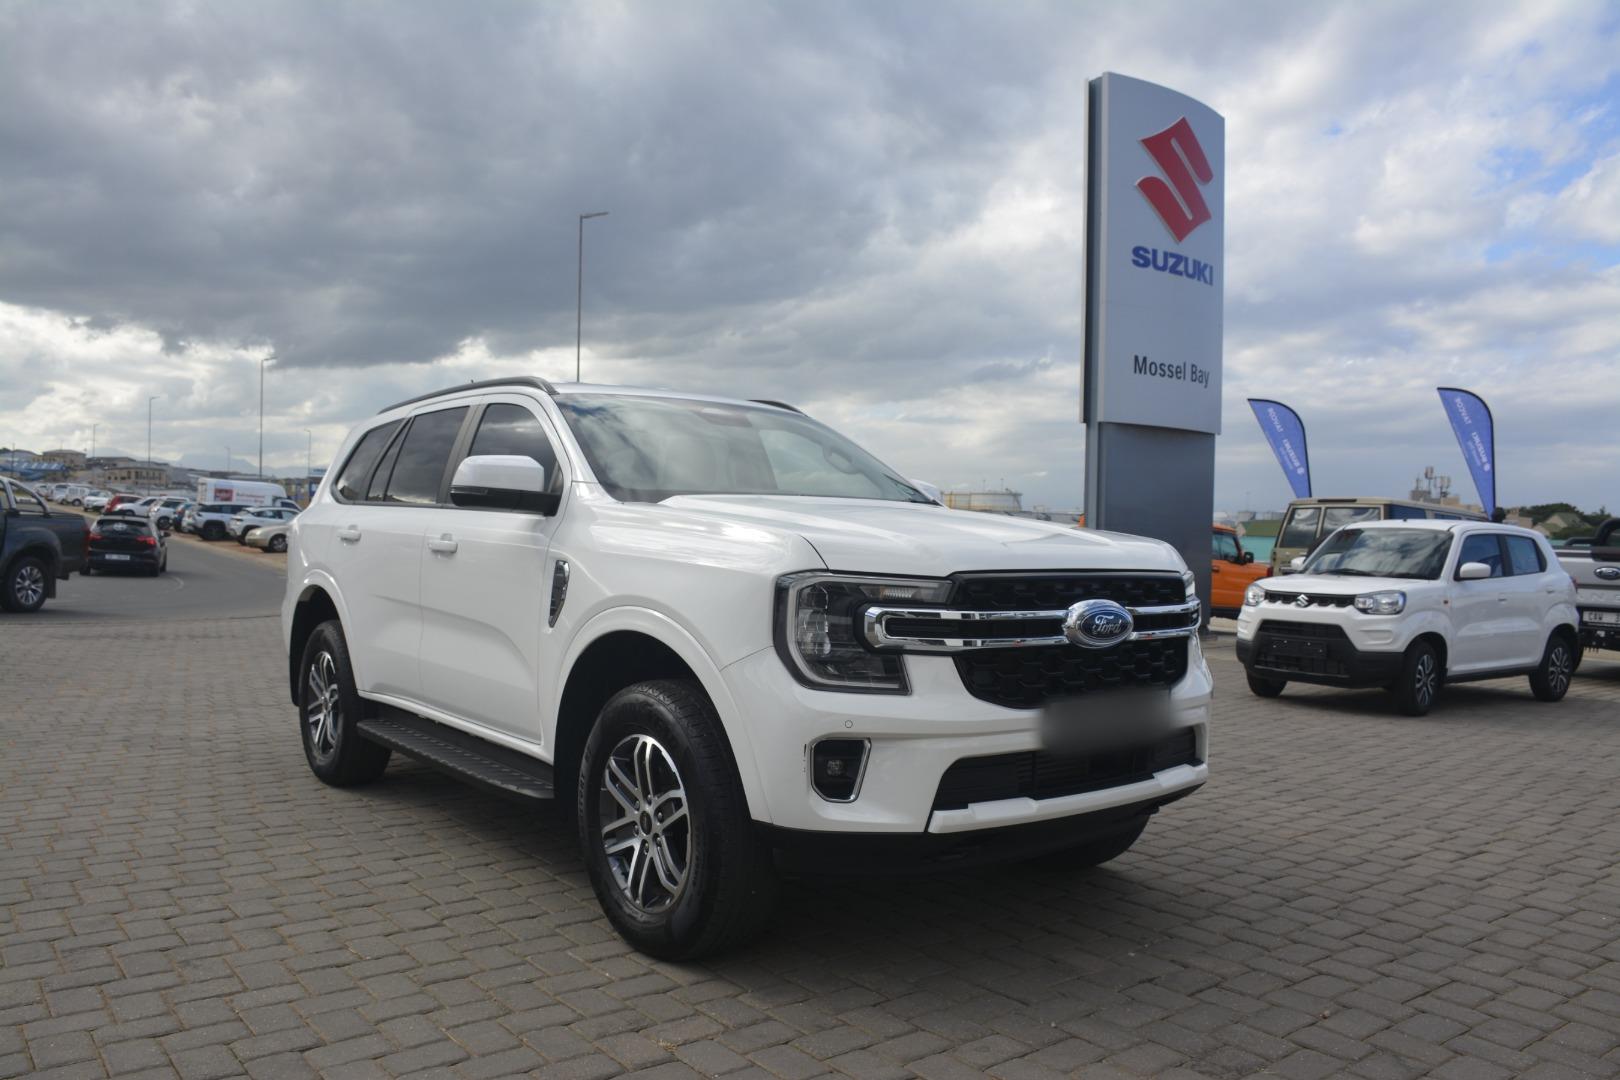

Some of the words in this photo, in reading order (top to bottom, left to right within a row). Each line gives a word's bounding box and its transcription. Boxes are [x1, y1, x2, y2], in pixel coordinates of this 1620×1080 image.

[1132, 245, 1213, 286] SUZUKI
[1133, 354, 1186, 381] Mossel
[1190, 363, 1210, 389] Bay
[1091, 614, 1122, 635] Ford
